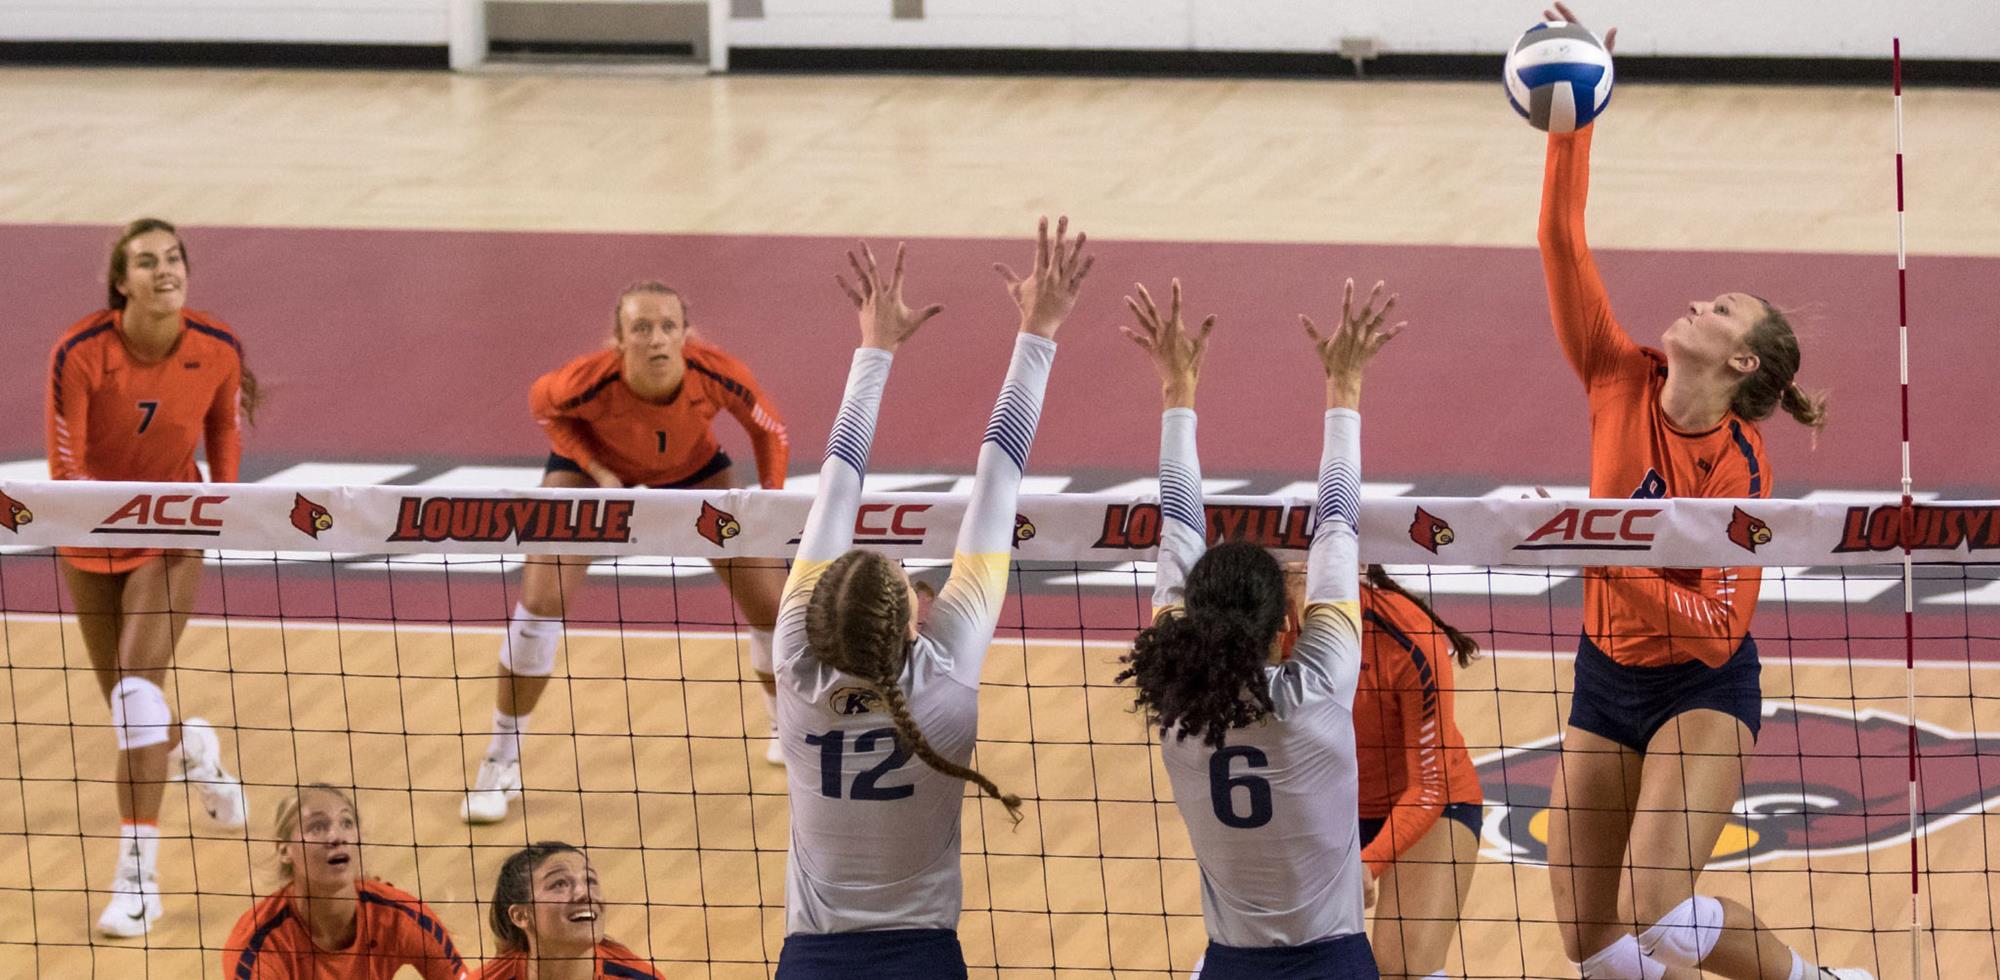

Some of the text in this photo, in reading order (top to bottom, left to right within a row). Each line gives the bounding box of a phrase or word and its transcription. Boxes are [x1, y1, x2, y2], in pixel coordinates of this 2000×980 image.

[135, 401, 159, 436] 7
[656, 430, 667, 453] 1
[101, 494, 230, 527] ACC
[386, 496, 635, 546] LOUISVILLE
[799, 504, 933, 536] CC
[1091, 503, 1317, 549] LOSVILL
[1525, 508, 1664, 542] ACC
[805, 727, 915, 801] 12
[1209, 745, 1273, 829] 6
